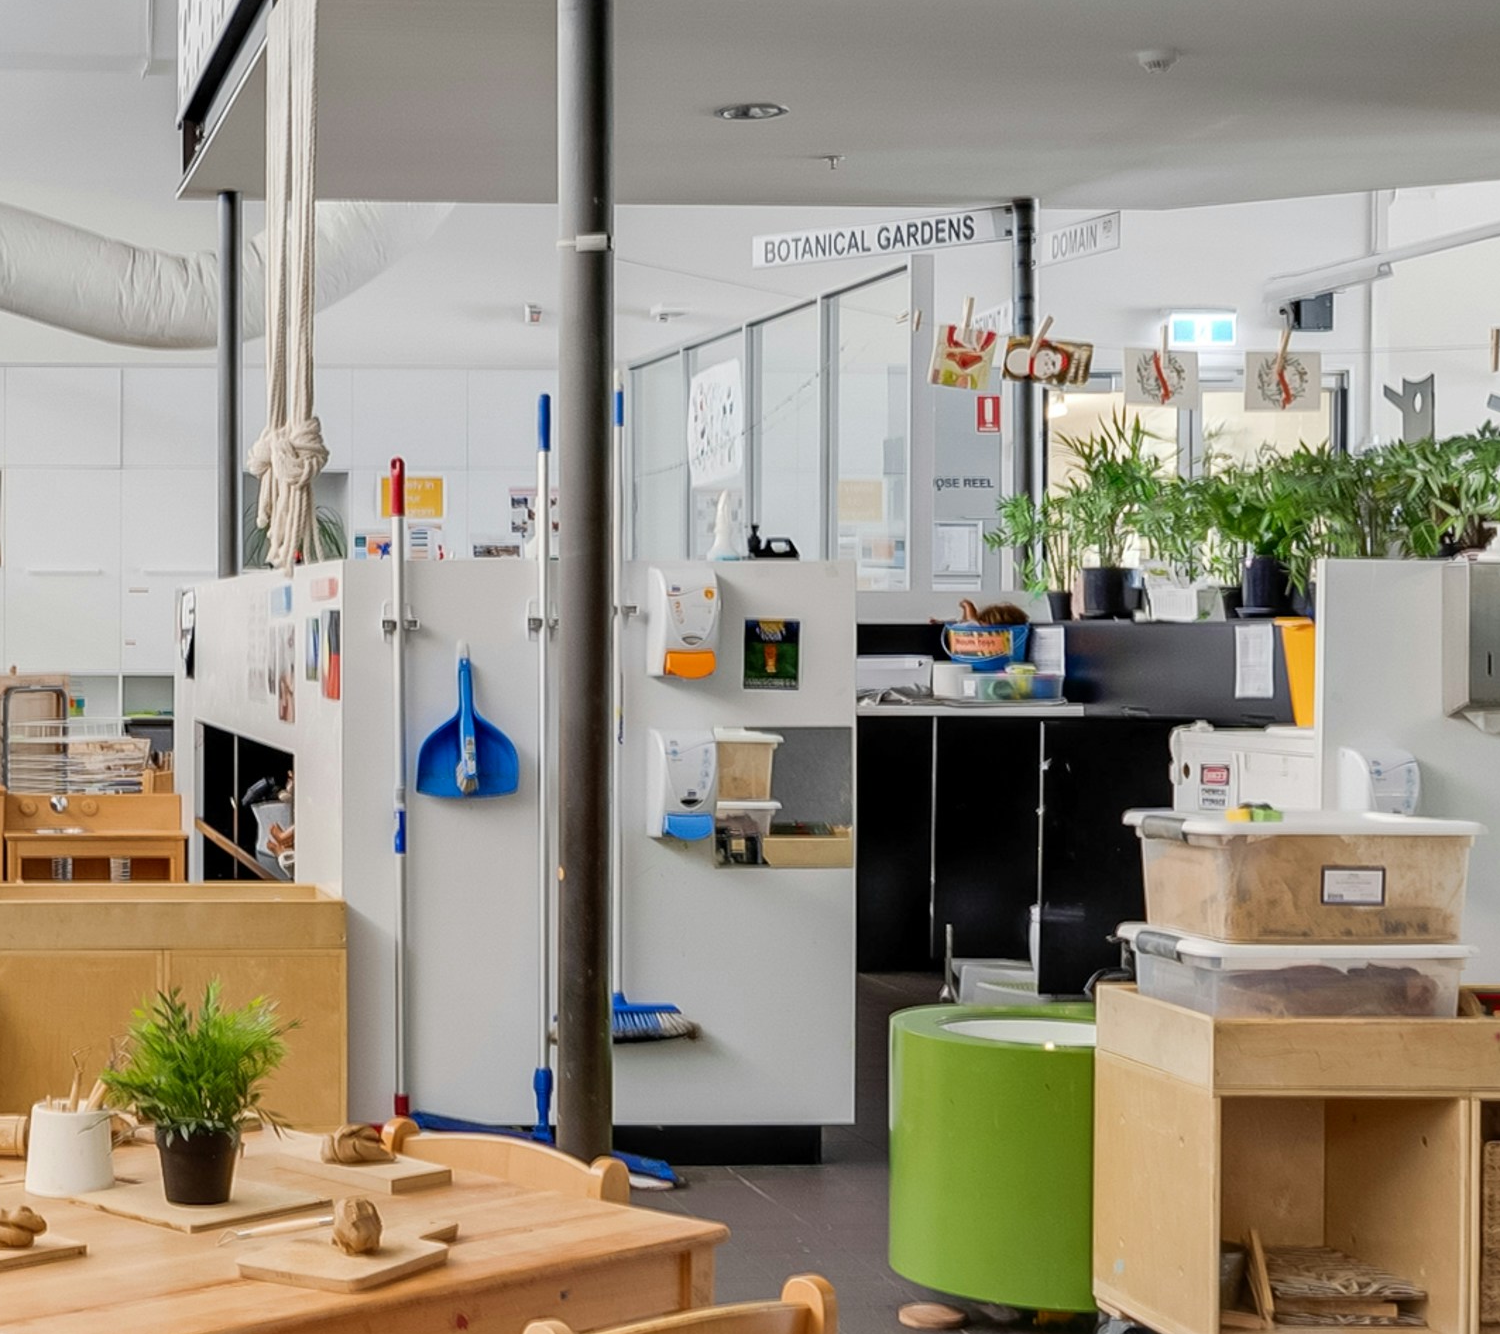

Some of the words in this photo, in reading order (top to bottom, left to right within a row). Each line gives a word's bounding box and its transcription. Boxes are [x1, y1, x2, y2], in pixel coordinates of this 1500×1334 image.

[763, 229, 871, 264] BOTANICAL
[877, 214, 975, 251] GARDENS
[1051, 223, 1098, 260] DOMAIN
[933, 477, 960, 491] OSE
[963, 477, 995, 489] REEL
